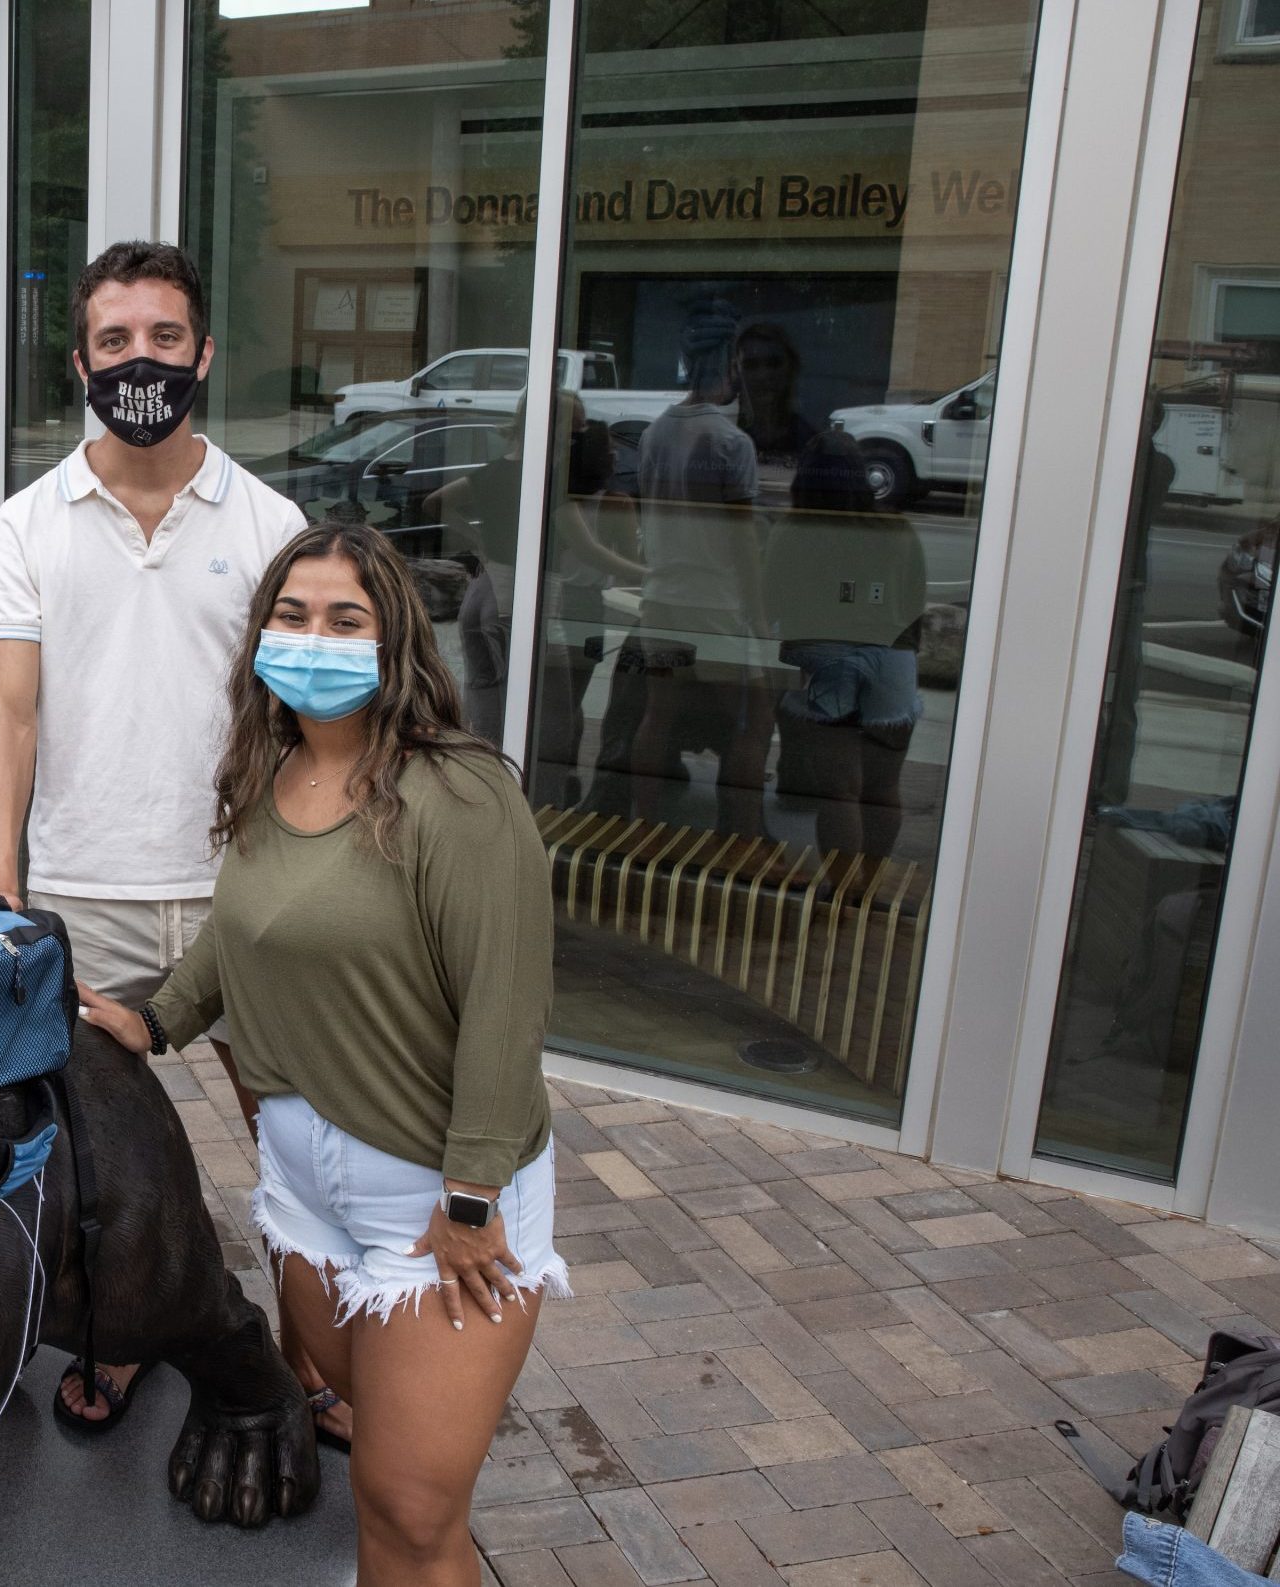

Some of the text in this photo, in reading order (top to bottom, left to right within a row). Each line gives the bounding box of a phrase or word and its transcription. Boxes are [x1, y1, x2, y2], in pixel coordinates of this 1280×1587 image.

[347, 186, 416, 229] The
[425, 185, 540, 226] Donna
[575, 179, 634, 222] nd
[646, 175, 764, 221] David
[777, 173, 909, 228] Bailey
[118, 380, 166, 400] BLACK
[120, 395, 163, 412] LIVES
[111, 404, 173, 425] MATTER
